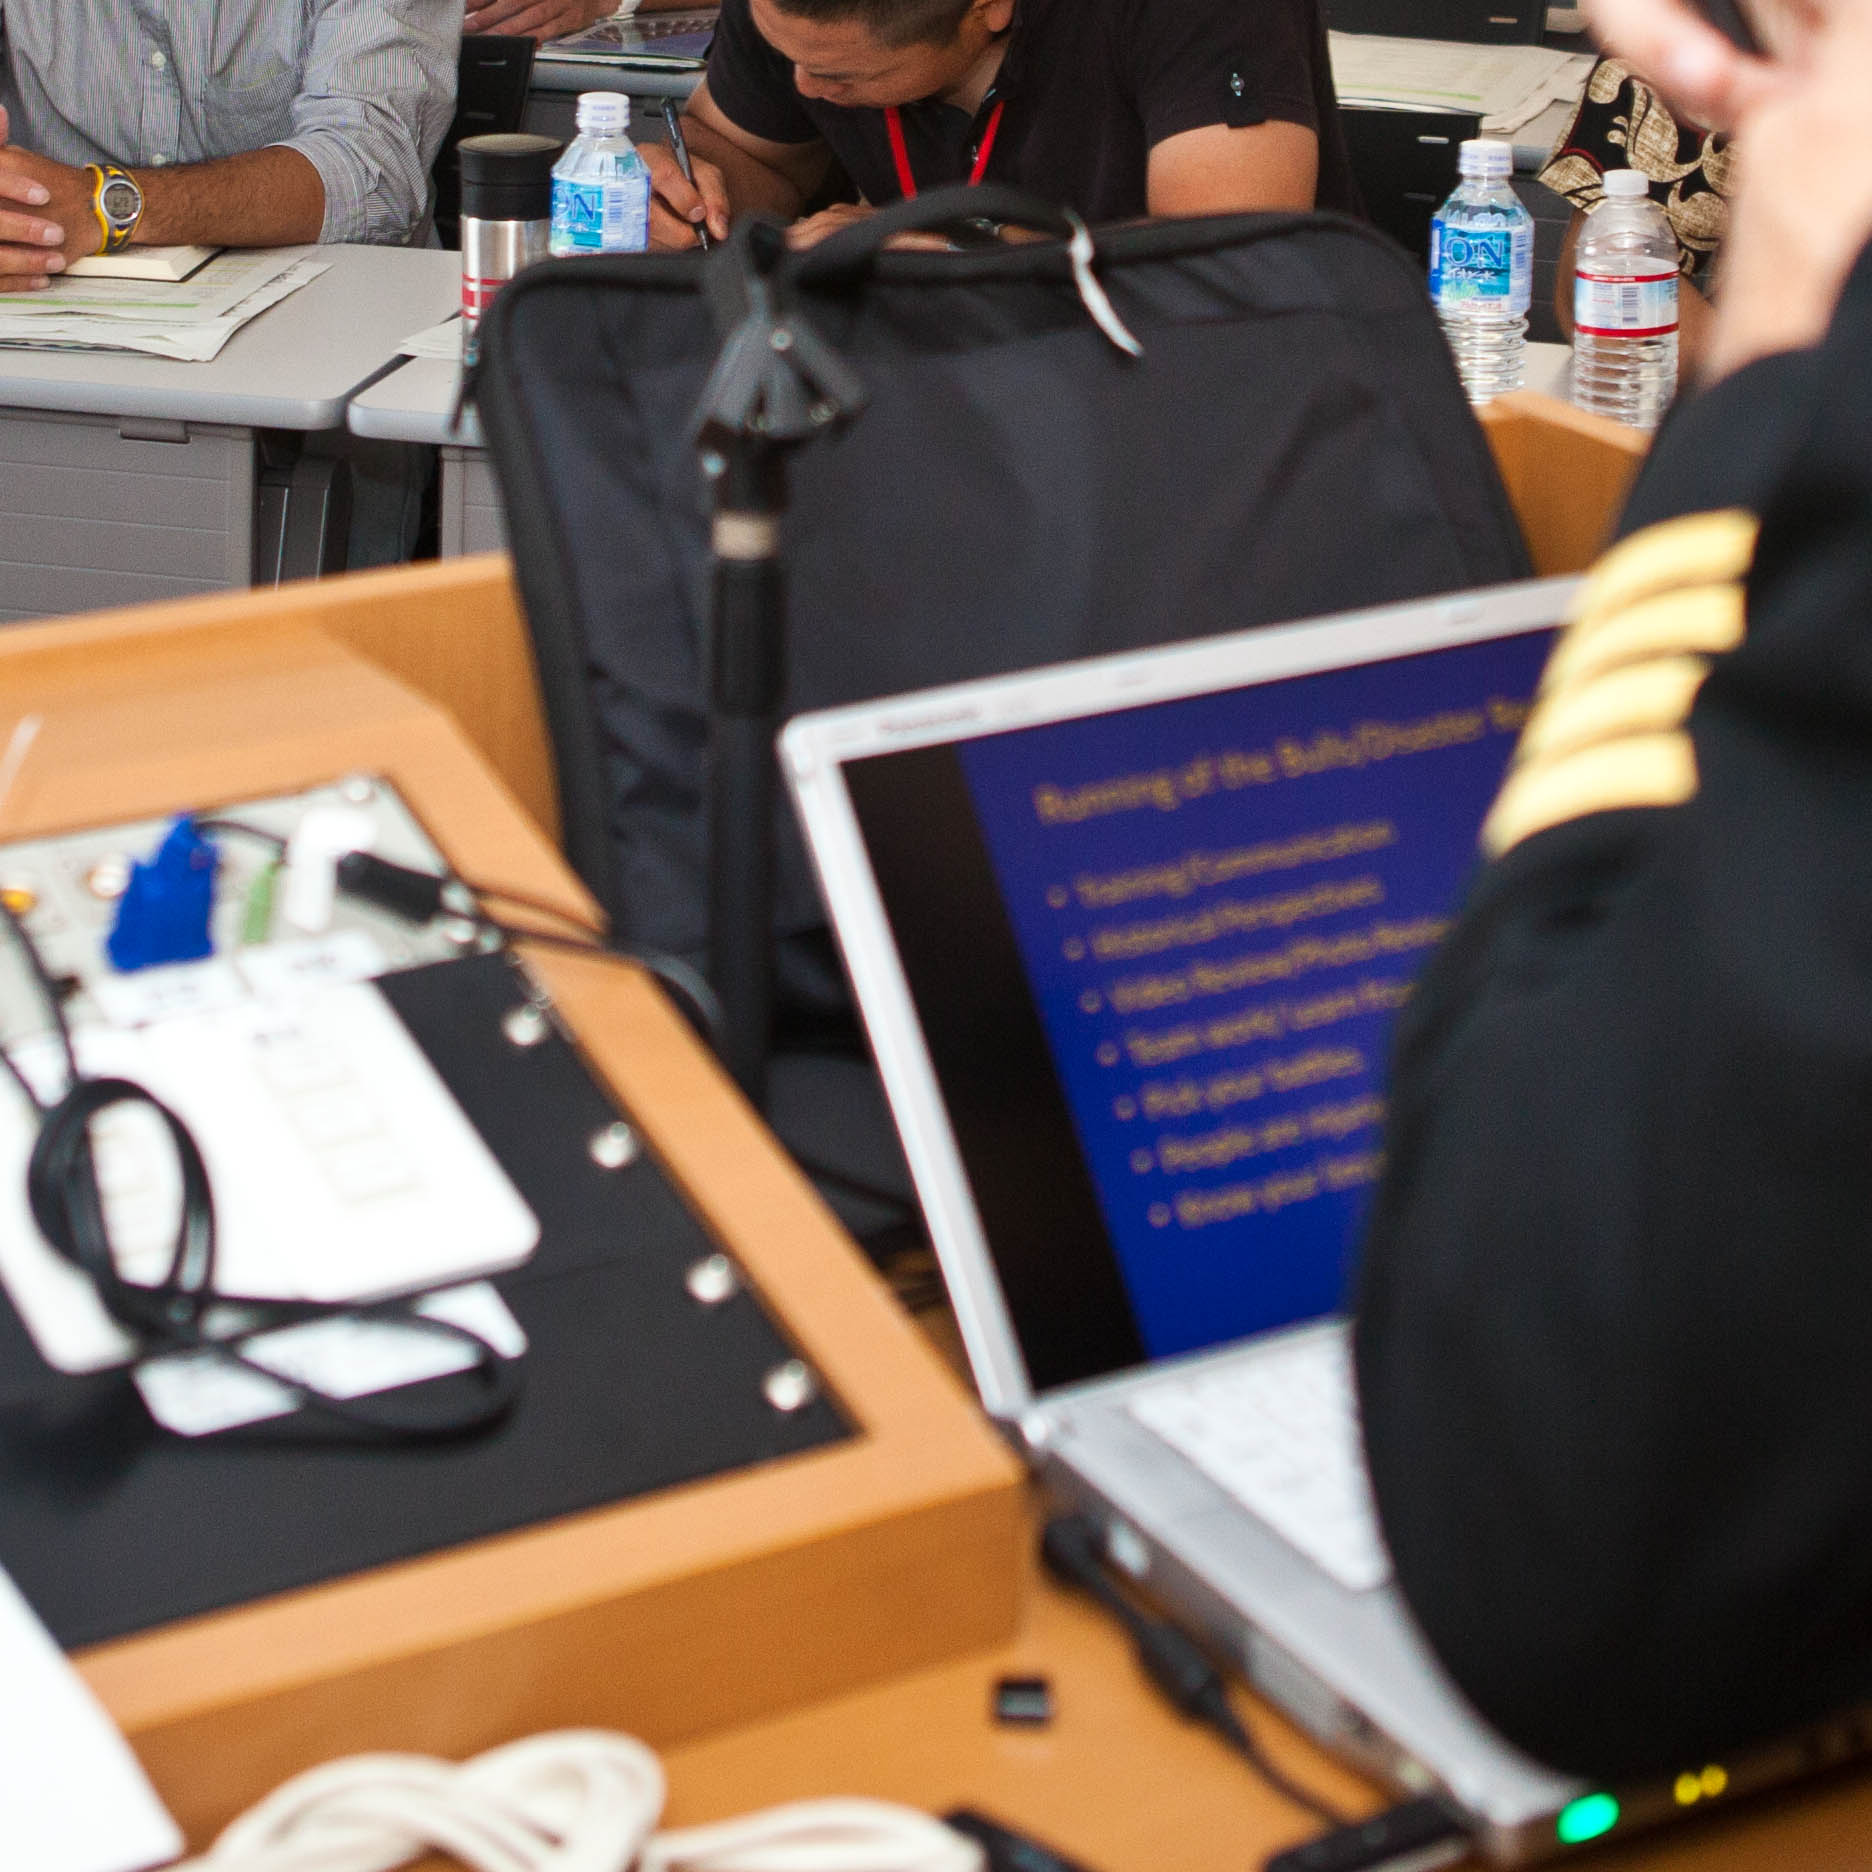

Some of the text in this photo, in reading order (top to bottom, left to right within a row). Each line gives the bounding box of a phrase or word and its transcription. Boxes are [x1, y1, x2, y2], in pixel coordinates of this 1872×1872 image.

[1036, 772, 1177, 823] Running
[1179, 756, 1215, 796] of
[1218, 747, 1276, 787] the
